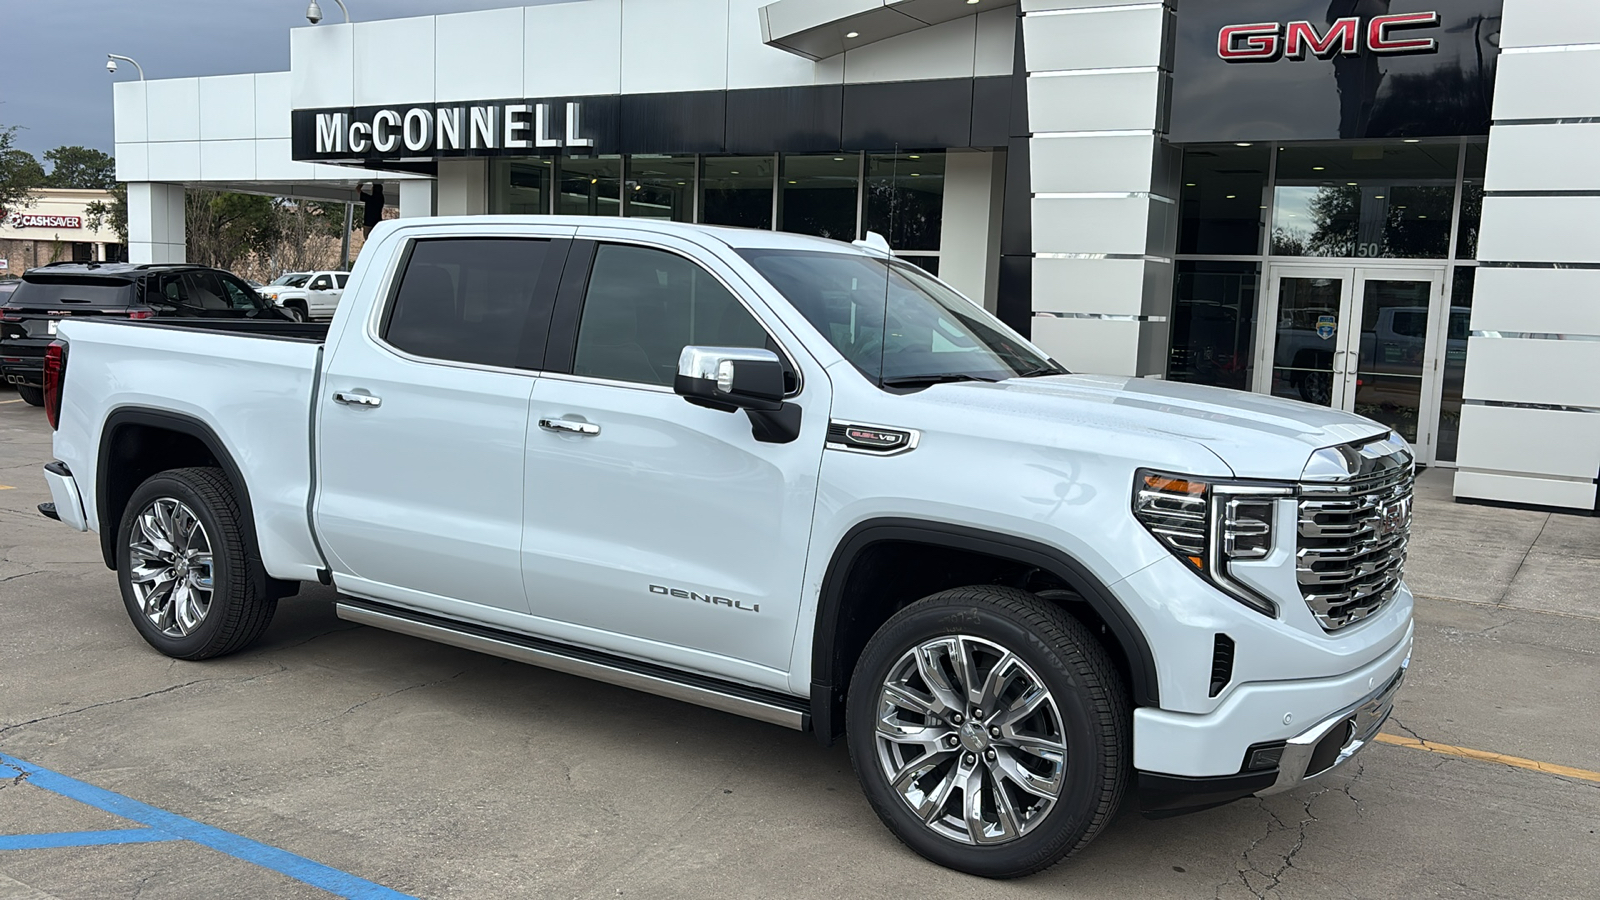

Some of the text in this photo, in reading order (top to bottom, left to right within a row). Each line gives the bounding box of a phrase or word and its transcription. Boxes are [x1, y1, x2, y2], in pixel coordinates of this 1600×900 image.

[1217, 10, 1438, 60] GMC
[315, 102, 593, 153] McCONNELL
[23, 215, 79, 227] CASHSAVER
[649, 584, 759, 613] DENALI
